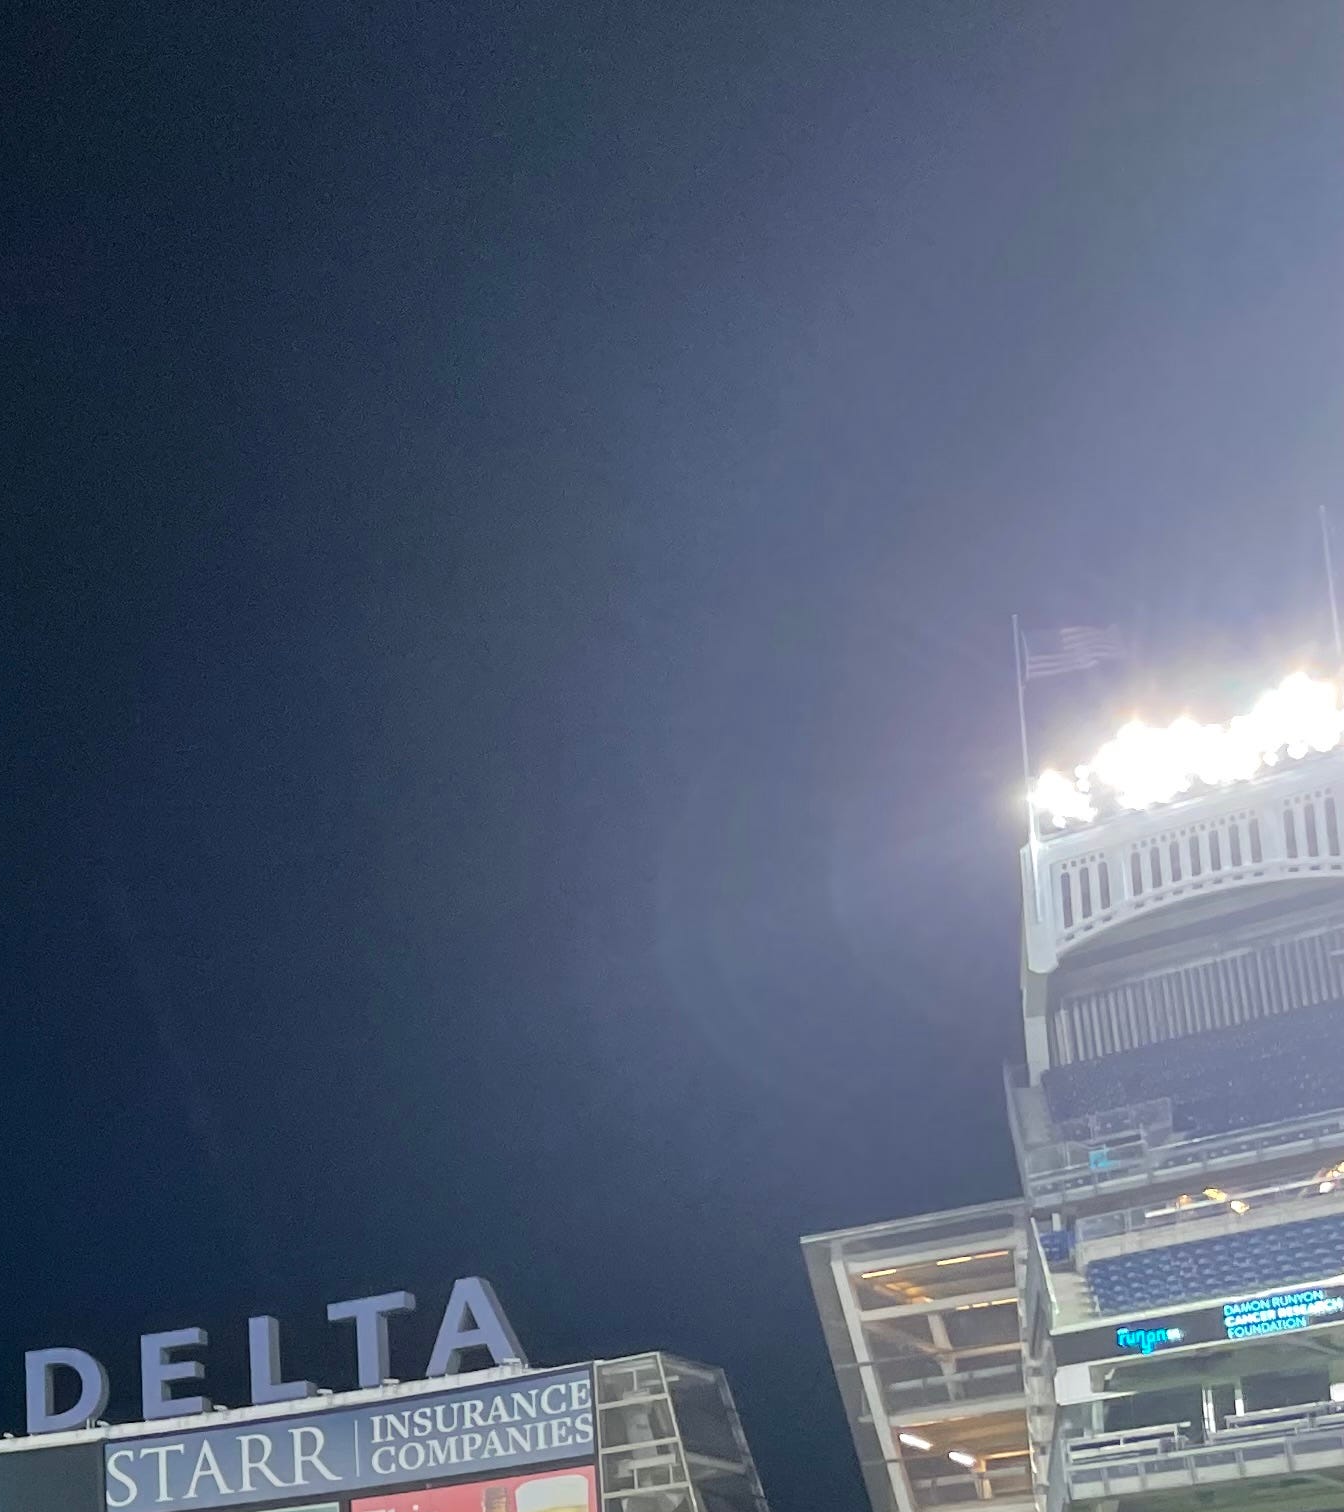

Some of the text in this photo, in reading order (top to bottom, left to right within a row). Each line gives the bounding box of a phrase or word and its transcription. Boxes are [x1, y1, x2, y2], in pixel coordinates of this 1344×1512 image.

[24, 1275, 529, 1434] DELTA
[370, 1378, 592, 1443] INSURANCE
[370, 1412, 594, 1475] COMPANIES
[105, 1425, 342, 1508] STARR
